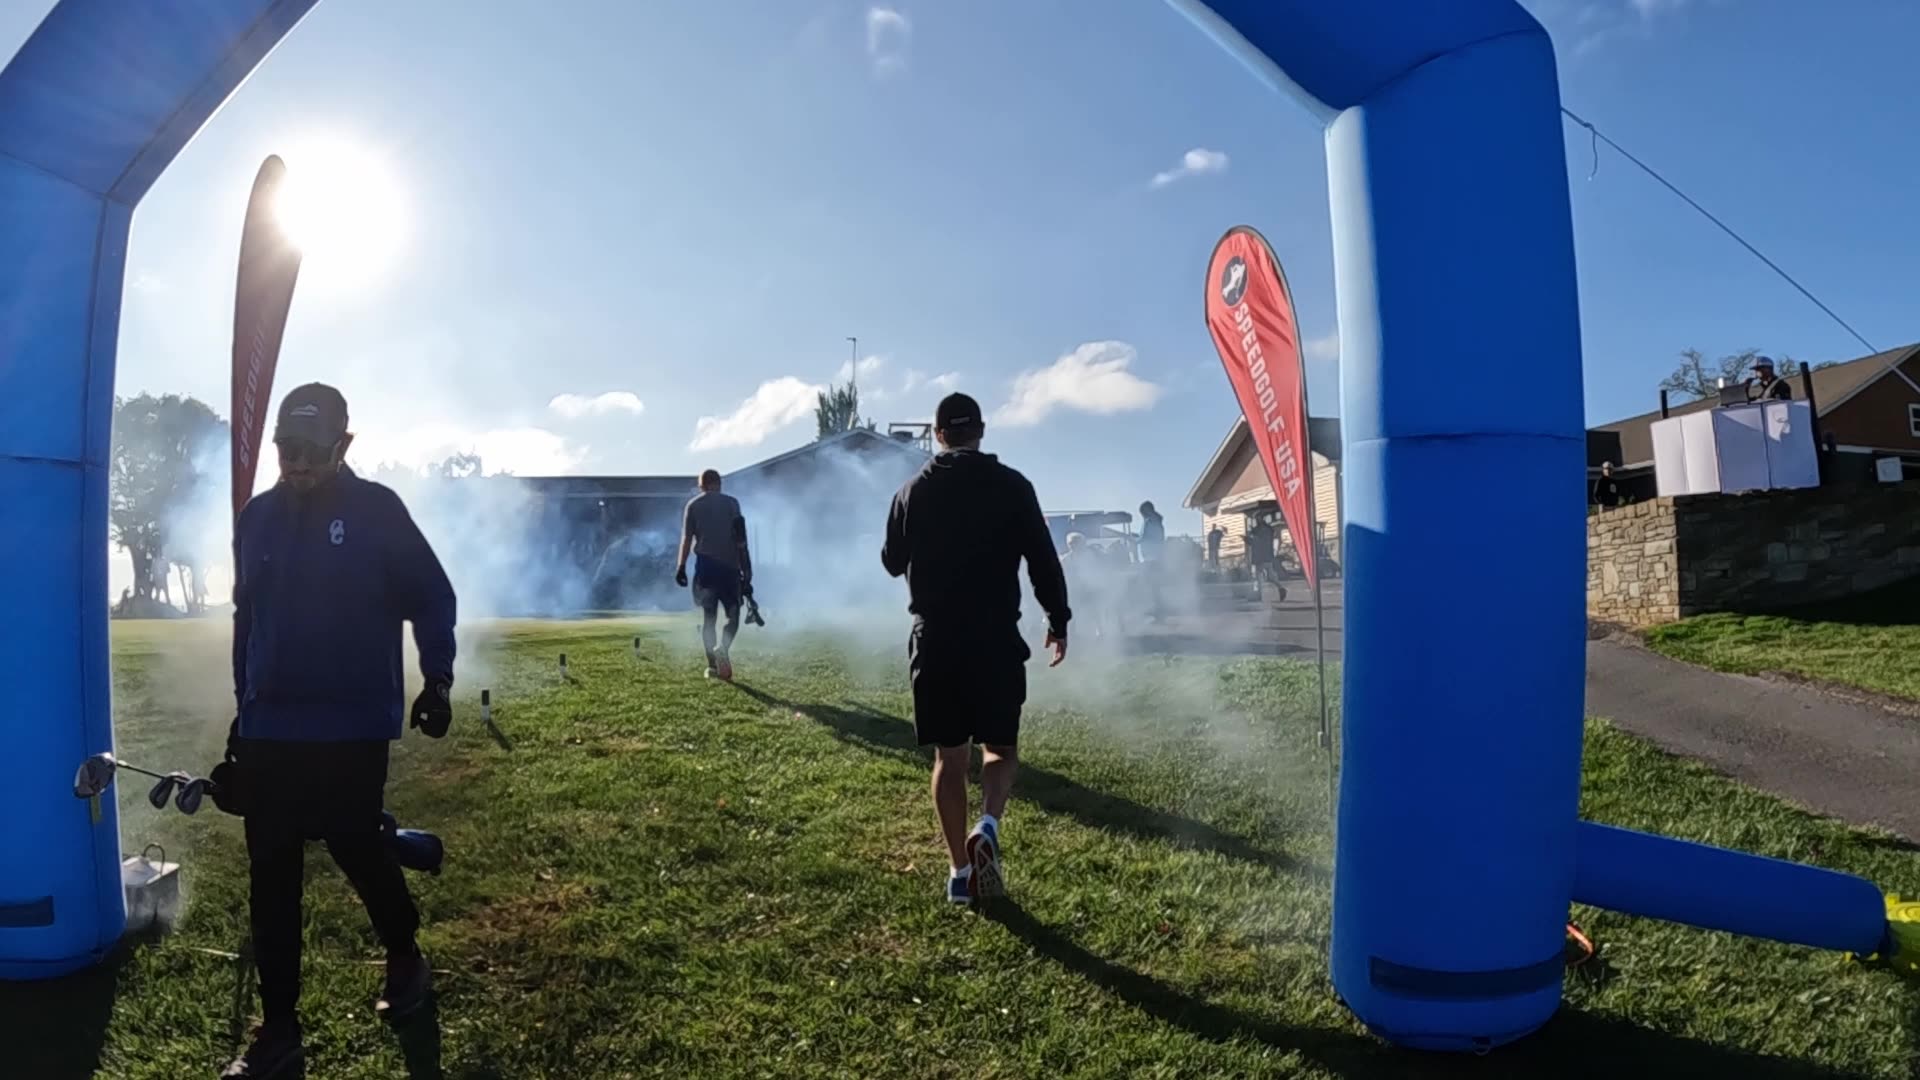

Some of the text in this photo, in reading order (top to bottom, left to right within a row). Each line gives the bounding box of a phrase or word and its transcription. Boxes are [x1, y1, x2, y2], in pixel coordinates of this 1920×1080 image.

[239, 322, 266, 470] SPEEDGOL
[1234, 302, 1301, 500] SPEEDGOLF USA
